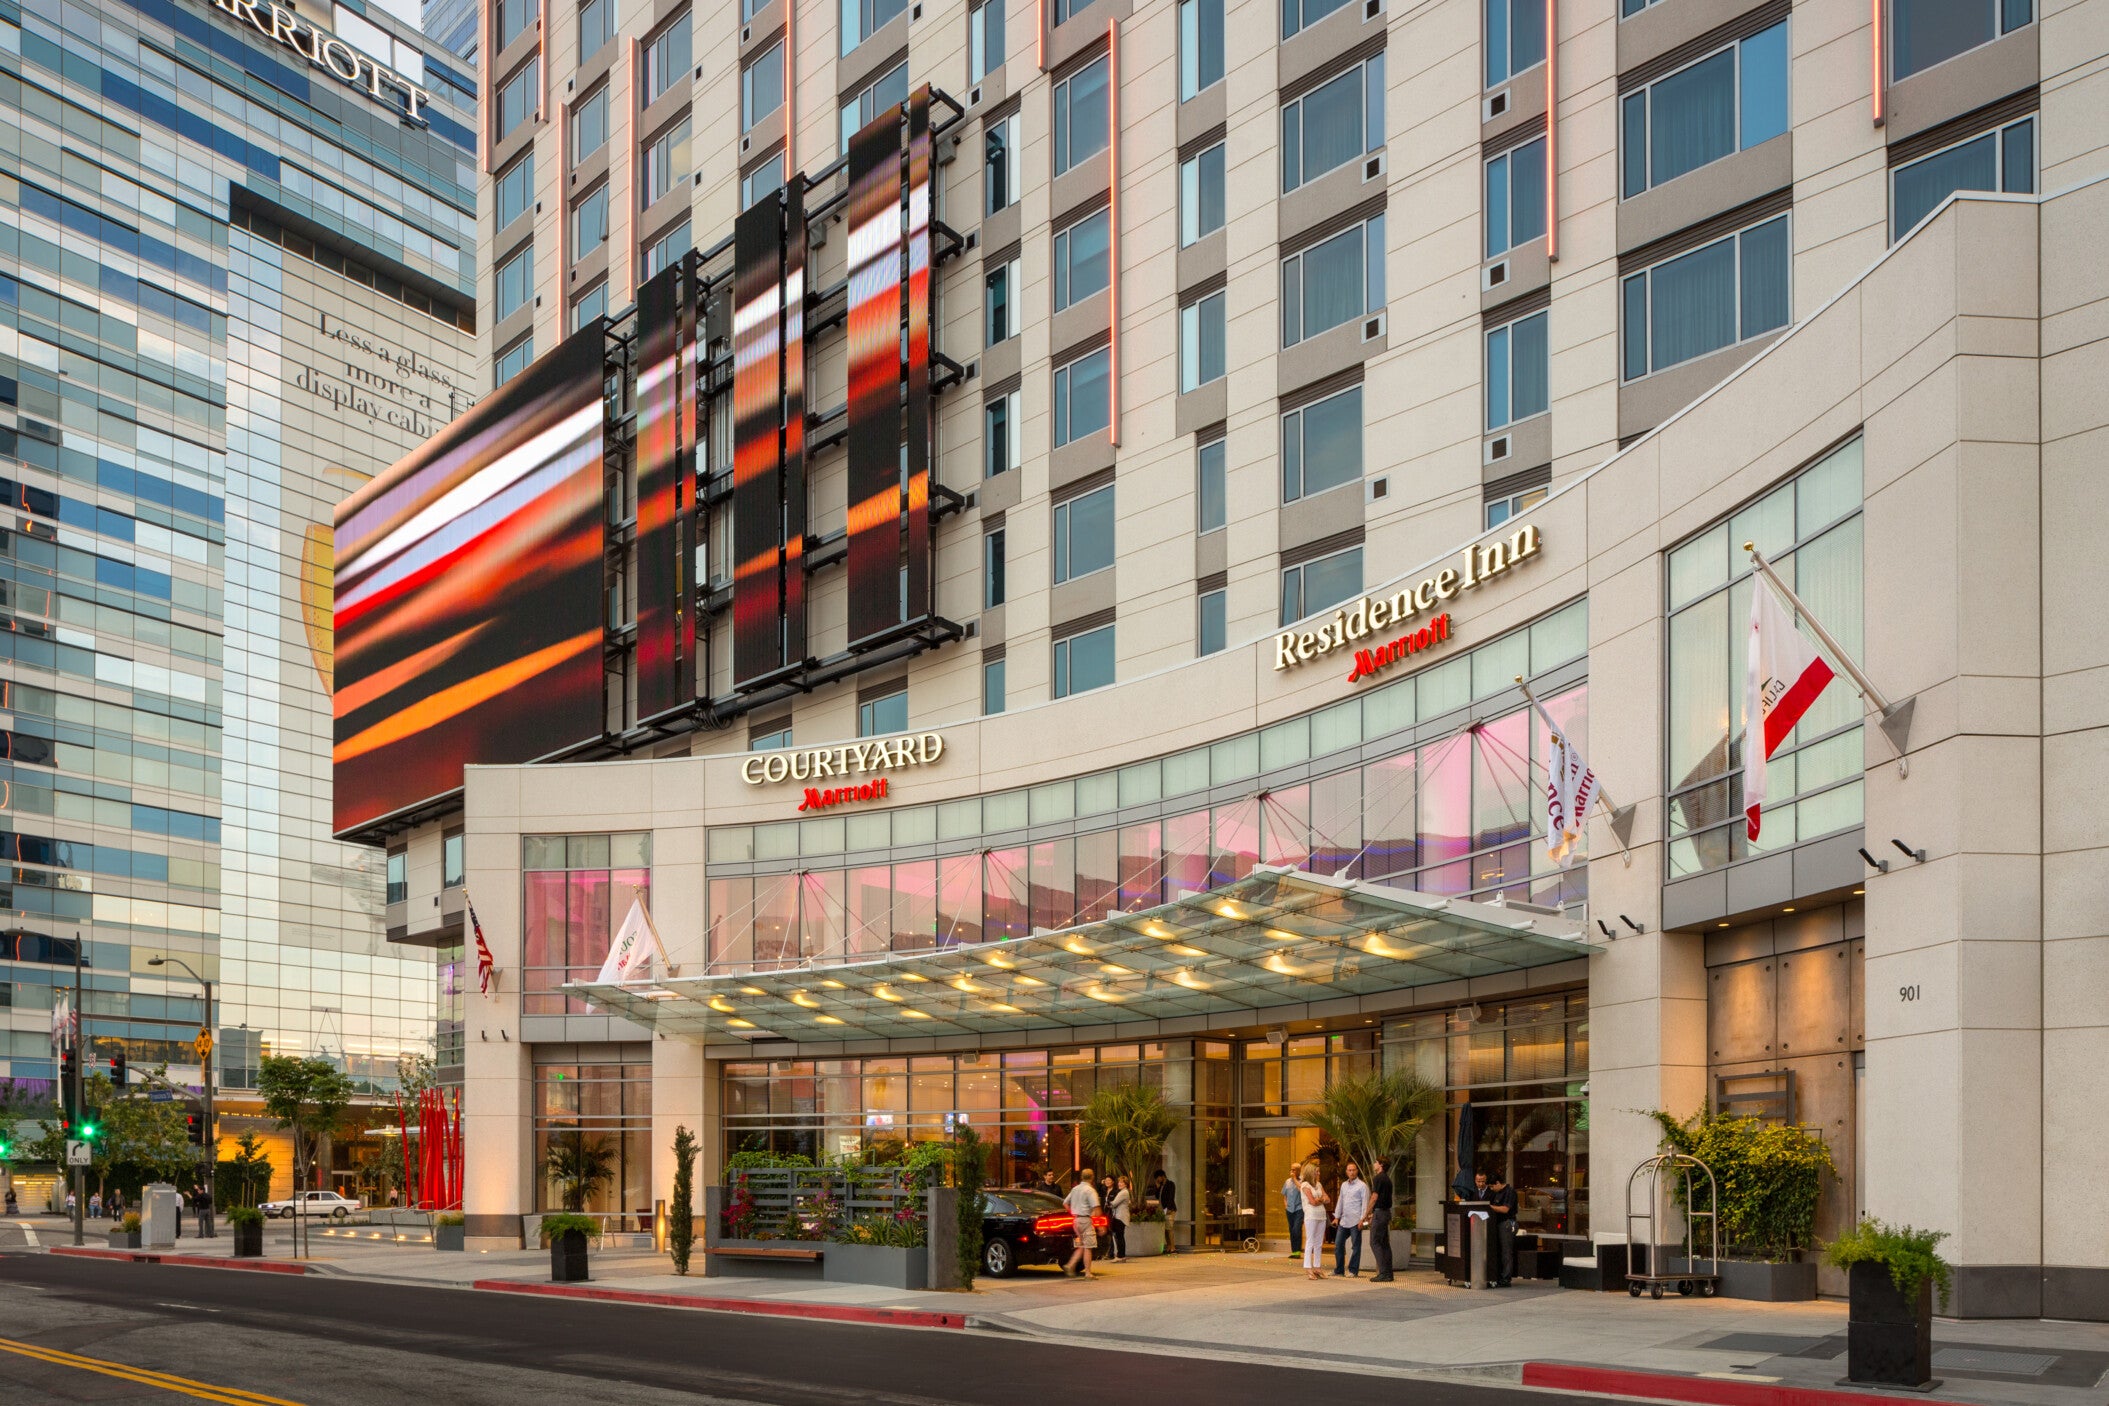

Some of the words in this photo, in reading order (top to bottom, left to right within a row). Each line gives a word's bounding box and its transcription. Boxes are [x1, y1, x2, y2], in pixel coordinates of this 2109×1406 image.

[211, 0, 430, 121] RRIOTT
[320, 313, 373, 356] Less
[378, 347, 390, 364] a
[296, 366, 382, 425] display
[346, 363, 413, 401] more
[419, 397, 431, 409] a
[1273, 568, 1459, 672] Residence
[1460, 524, 1542, 590] Inn
[1347, 613, 1451, 683] Marriott
[741, 733, 945, 785] COURTYARD
[798, 777, 889, 811] Marriott
[1900, 984, 1920, 1002] 901
